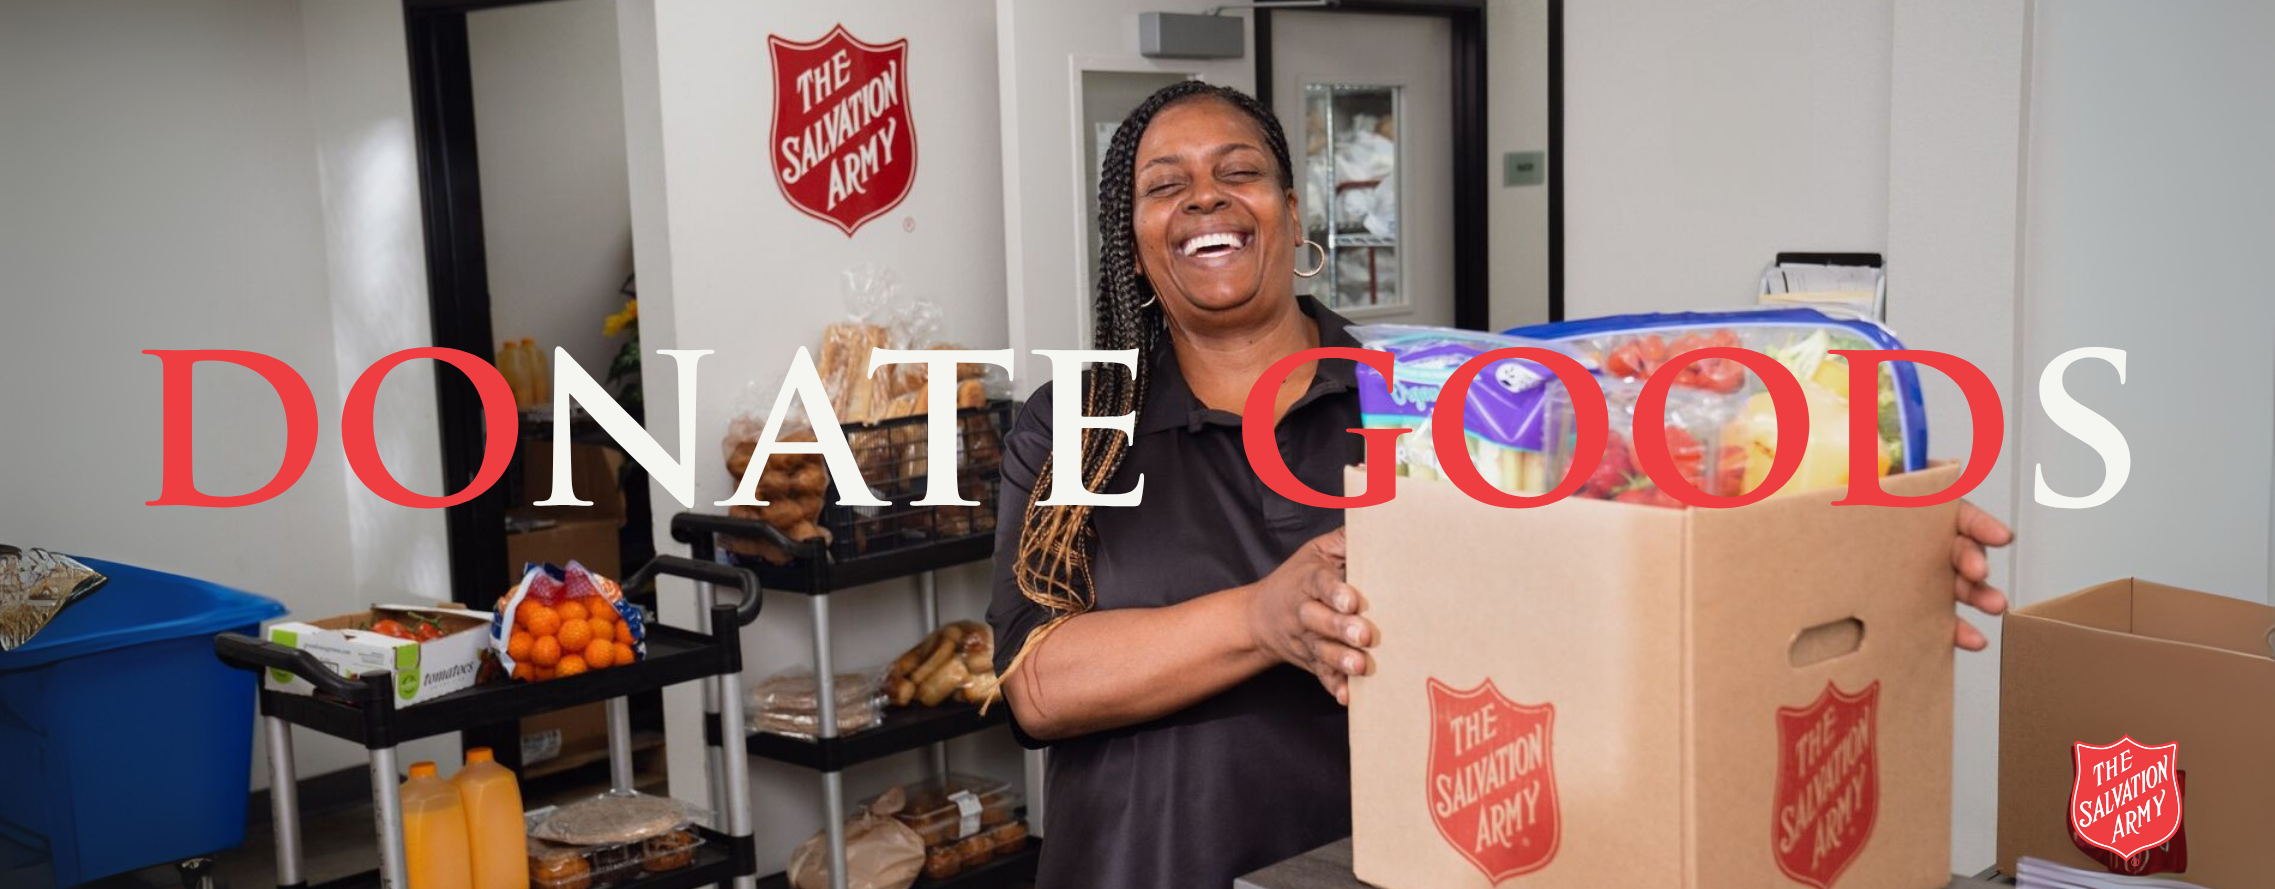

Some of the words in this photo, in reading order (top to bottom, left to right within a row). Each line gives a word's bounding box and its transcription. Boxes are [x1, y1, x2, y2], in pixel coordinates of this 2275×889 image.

[781, 59, 898, 184] SALVATION
[796, 49, 851, 114] THE
[827, 117, 897, 212] ARMY
[423, 661, 475, 687] tomatoes
[1436, 723, 1544, 818] SALVATION
[1450, 702, 1499, 757] THE
[1795, 704, 1837, 778] THE
[1475, 780, 1541, 854] ARMY
[1779, 704, 1870, 853] SALVATION
[1811, 762, 1867, 871] ARMY
